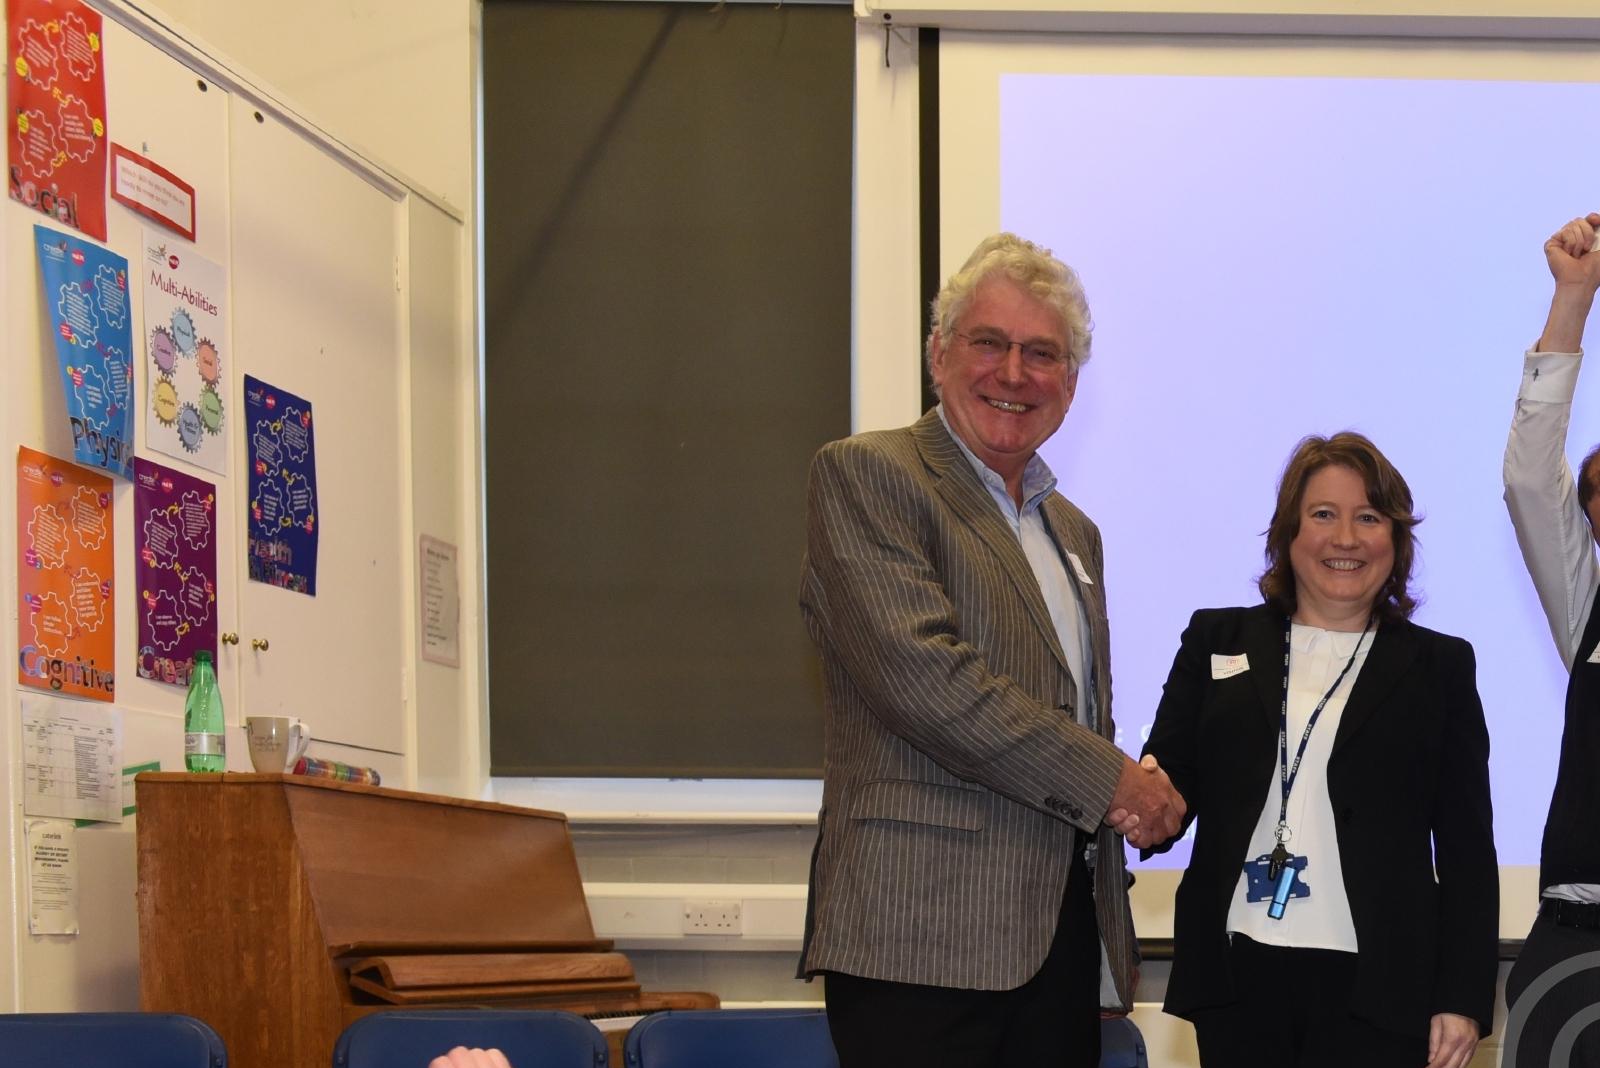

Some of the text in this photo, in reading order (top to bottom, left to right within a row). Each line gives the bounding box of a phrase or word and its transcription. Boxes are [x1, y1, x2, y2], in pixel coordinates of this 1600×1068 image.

[9, 166, 80, 229] Social
[150, 269, 218, 316] Multi-Abilities
[20, 645, 115, 693] Cognitive
[138, 645, 193, 686] Creat
